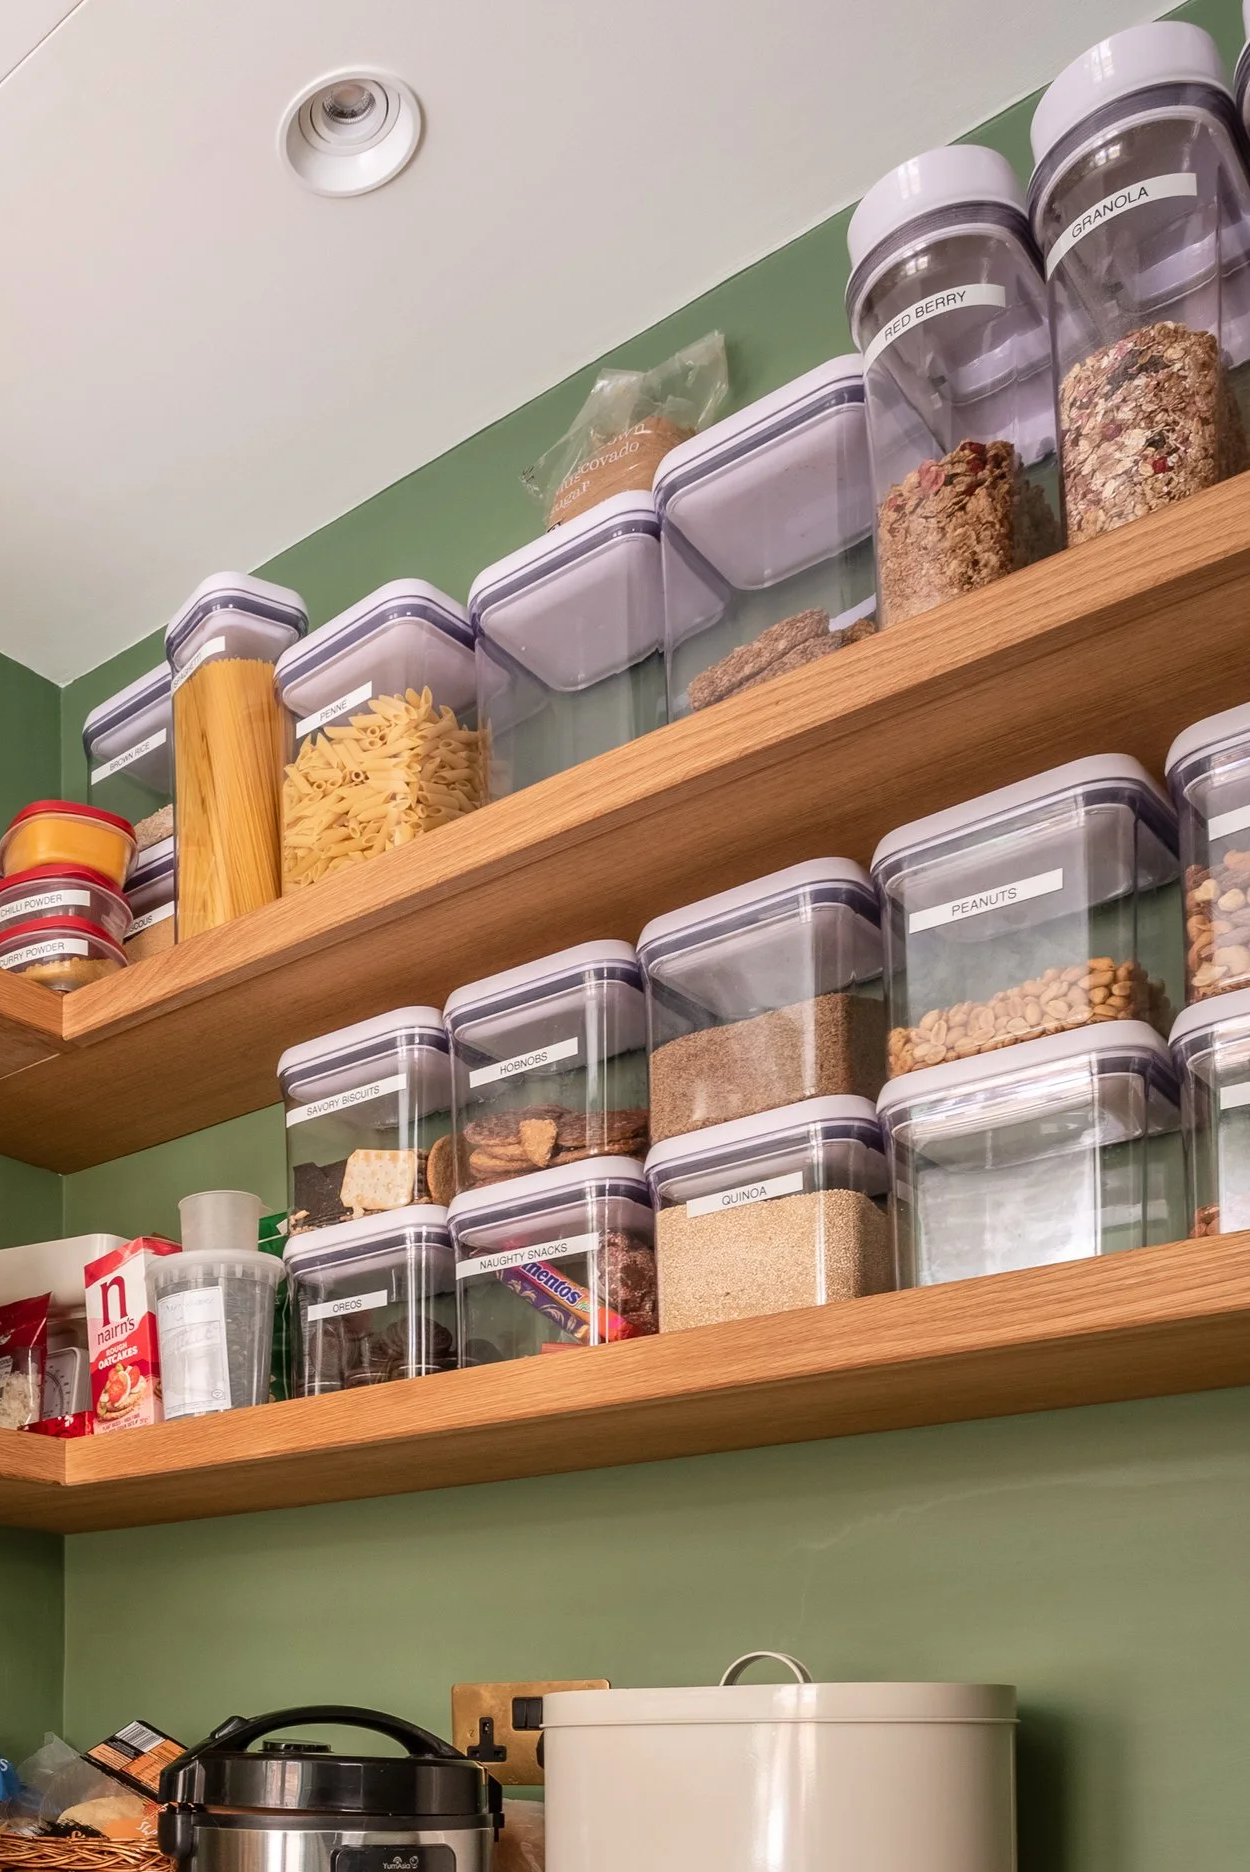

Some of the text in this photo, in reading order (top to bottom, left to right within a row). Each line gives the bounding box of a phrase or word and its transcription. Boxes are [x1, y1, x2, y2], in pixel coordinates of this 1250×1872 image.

[1070, 186, 1150, 239] GRANOLA
[884, 290, 967, 341] RED BERRY
[319, 699, 348, 722] PENNE
[109, 741, 150, 771] BROWN RICE
[0, 893, 63, 918] CHILLI POWDER
[951, 887, 1018, 917] PEANUTS
[25, 941, 65, 958] POWDER
[500, 1051, 549, 1076] HOBNOBS
[306, 1084, 381, 1117] SAVORY BISCUITS
[721, 1186, 767, 1206] QUINOA
[479, 1242, 568, 1270] NAUGHTY SNACKS
[520, 1260, 583, 1306] mentos
[332, 1299, 363, 1313] OREOS
[97, 1316, 136, 1345] nairn's
[97, 1346, 139, 1370] OATCAKES
[105, 1342, 128, 1356] ROUGH
